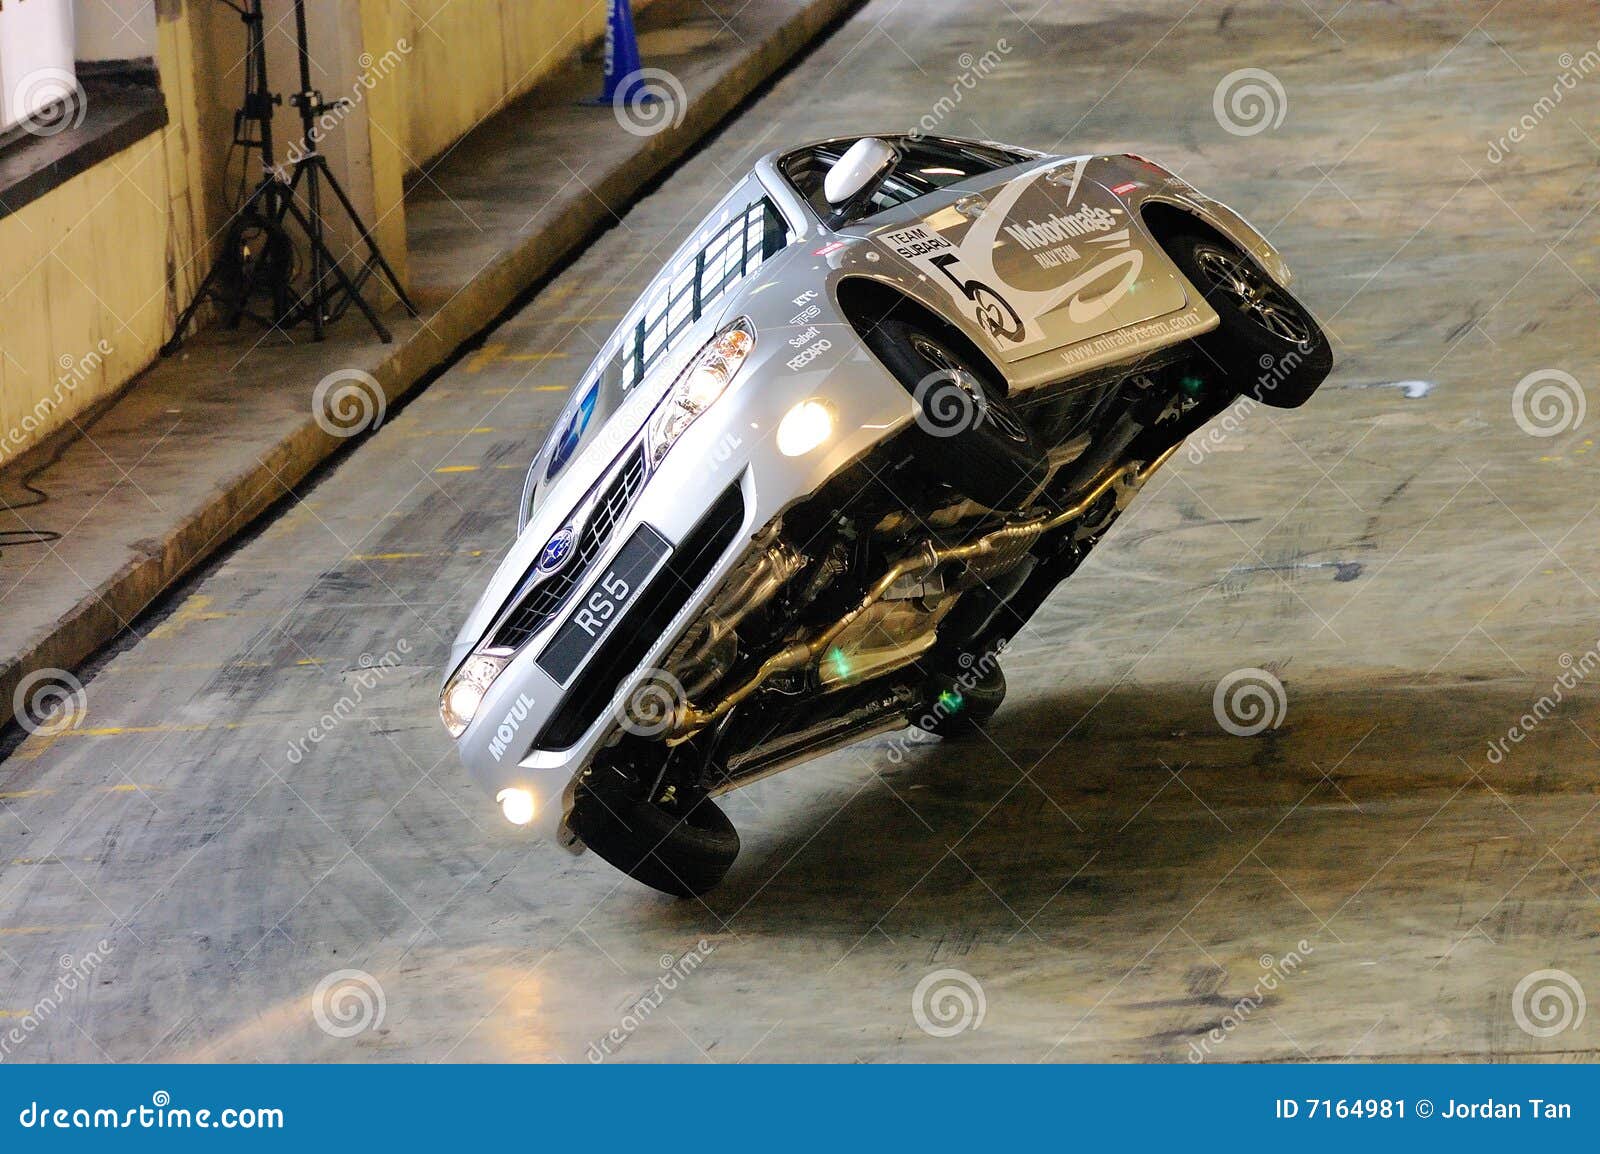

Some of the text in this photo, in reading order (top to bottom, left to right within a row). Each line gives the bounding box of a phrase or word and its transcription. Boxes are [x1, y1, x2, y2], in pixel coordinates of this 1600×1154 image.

[887, 228, 929, 245] TEAM
[896, 236, 952, 259] SUBARU
[928, 253, 1026, 343] 5
[786, 338, 832, 371] RECARO
[1060, 311, 1200, 365] www.mirallyteam.com
[487, 693, 536, 763] MOTUL
